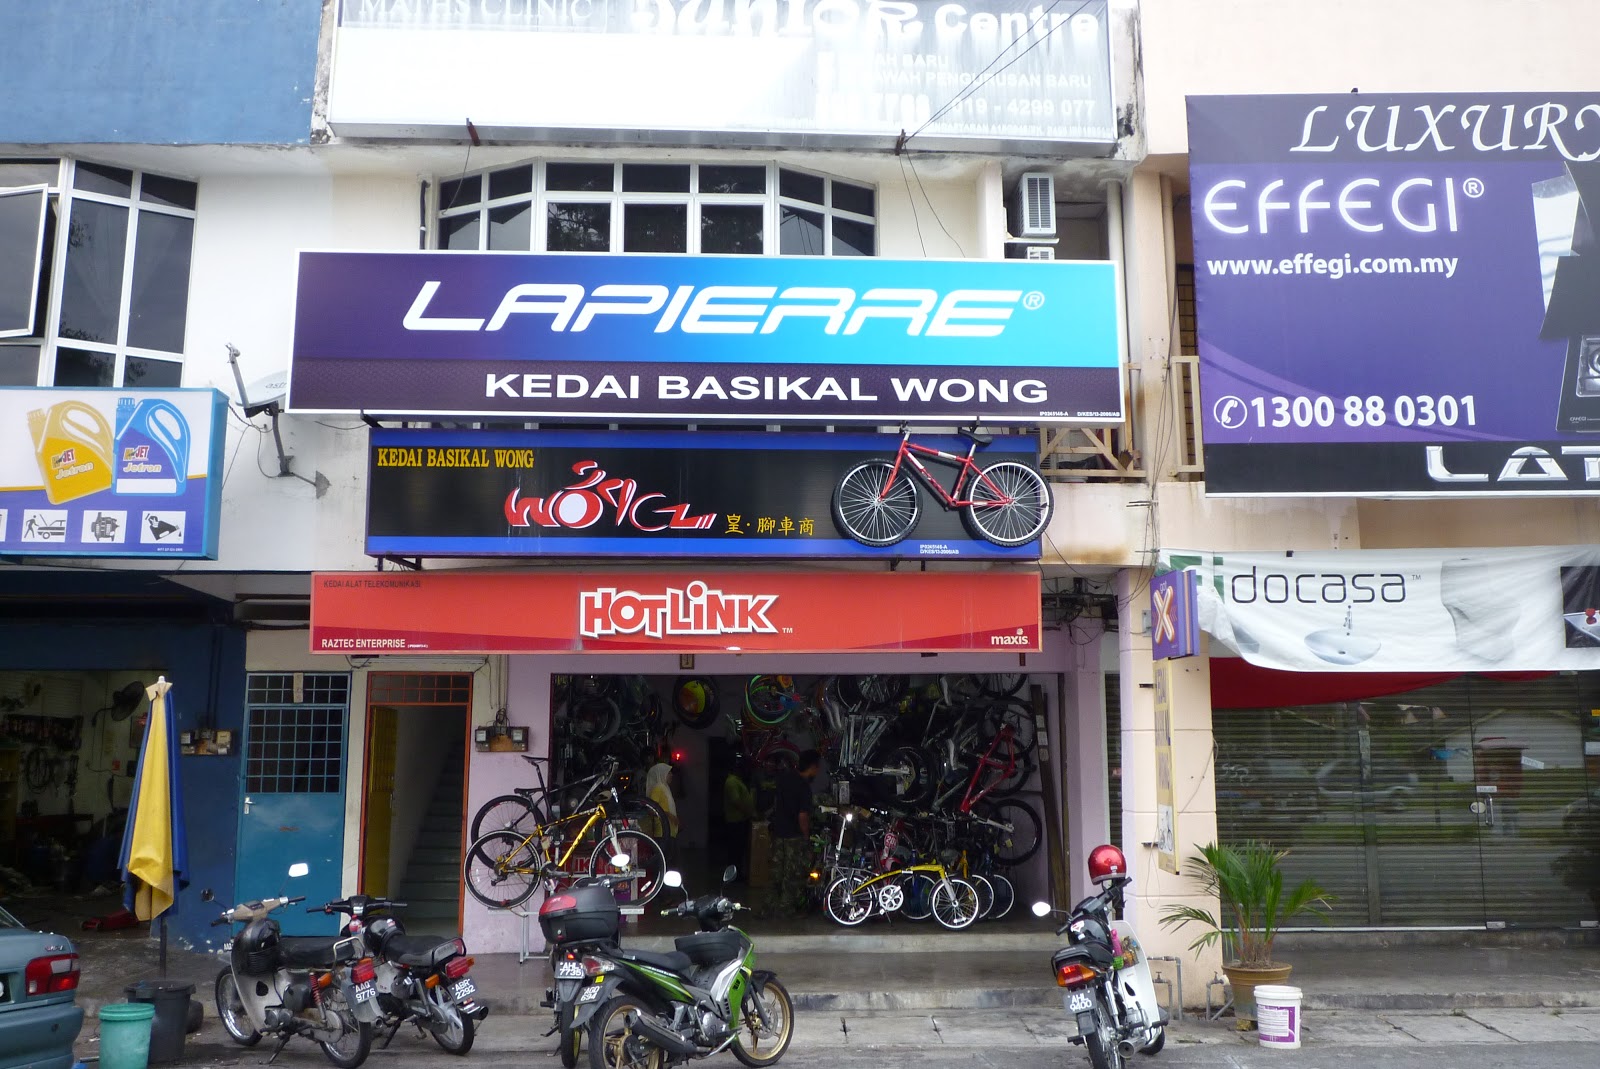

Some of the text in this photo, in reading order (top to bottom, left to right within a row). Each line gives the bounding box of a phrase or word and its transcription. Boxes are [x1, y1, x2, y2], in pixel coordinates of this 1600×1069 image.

[1206, 253, 1459, 279] www.effegi.com.my
[485, 373, 1049, 404] KEDAI BASIKAL WONG
[1251, 395, 1477, 428] 1300 88 0301
[122, 462, 162, 473] Jetron
[377, 448, 535, 469] KEDAI BASIKAL WONG
[55, 462, 94, 480] Jetron
[1231, 566, 1406, 604] docasa
[321, 638, 406, 649] RAZTEC ENTERPRISE
[991, 634, 1028, 646] maxis
[356, 989, 376, 1001] 9776
[455, 985, 476, 1000] 2292
